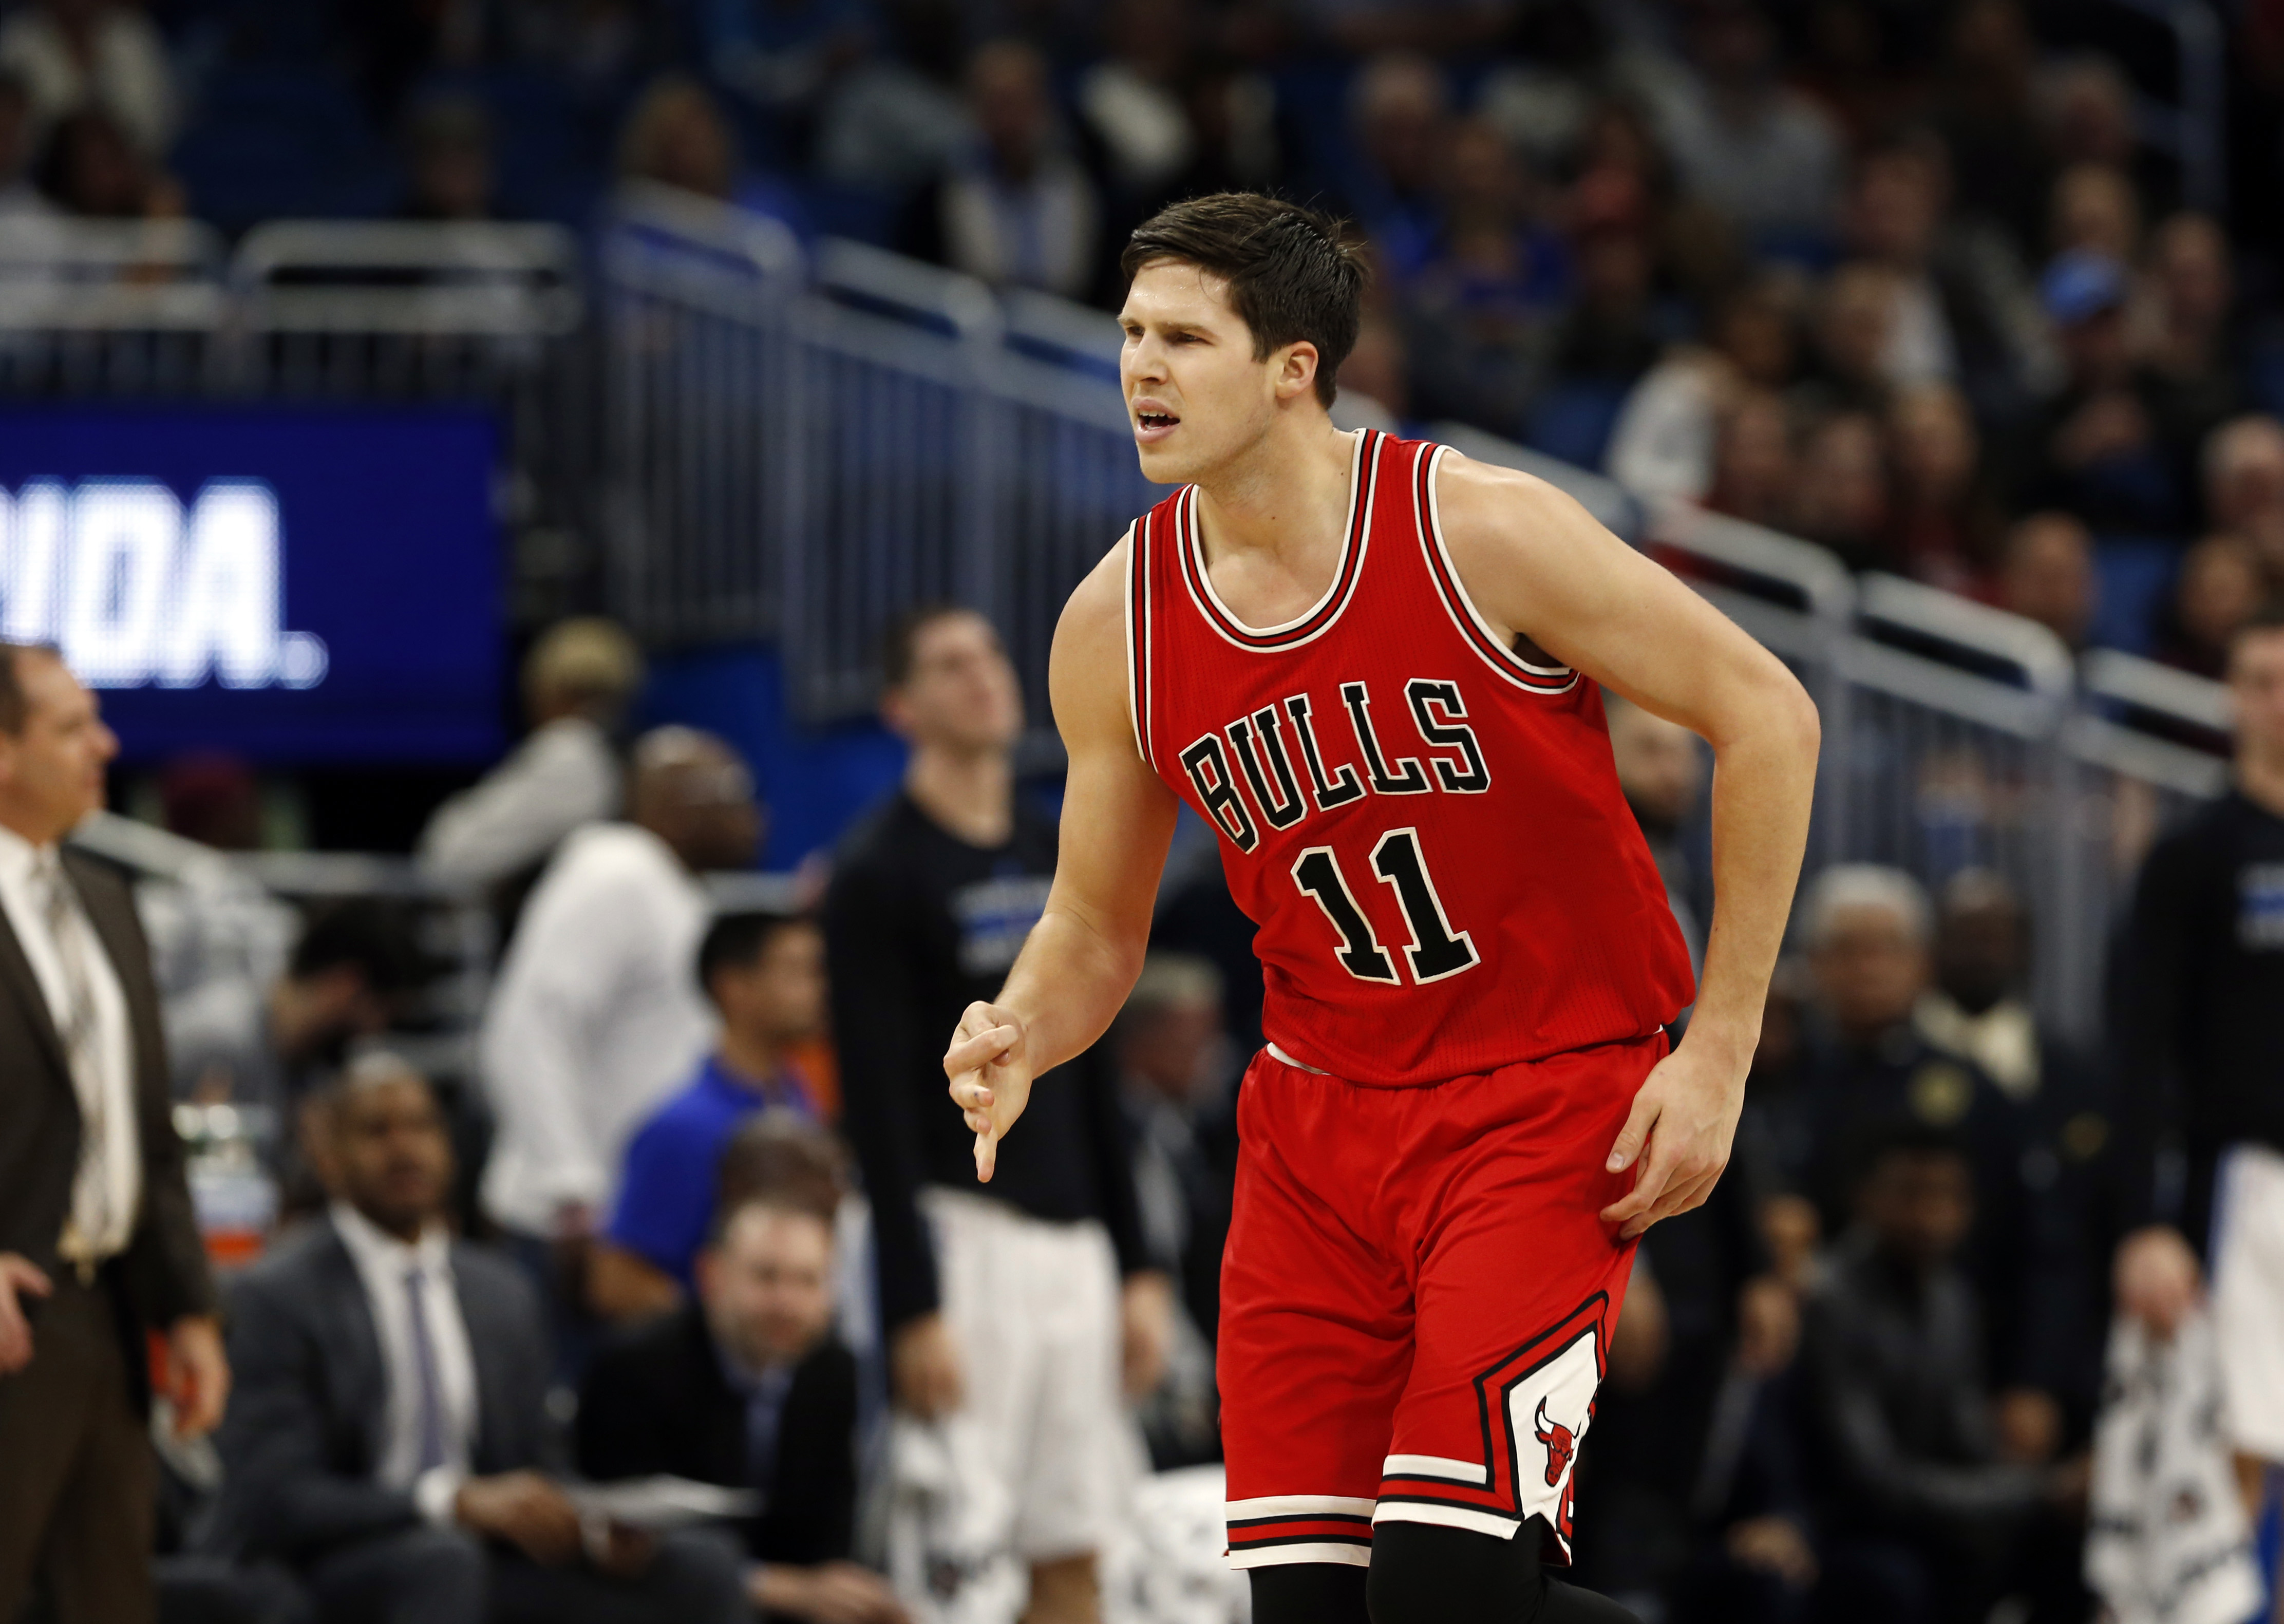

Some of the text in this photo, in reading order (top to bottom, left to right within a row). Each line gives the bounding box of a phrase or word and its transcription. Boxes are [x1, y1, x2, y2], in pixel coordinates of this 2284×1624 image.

[0, 476, 329, 689] IDA.
[1178, 677, 1492, 855] BULLS
[1290, 826, 1481, 986] 11
